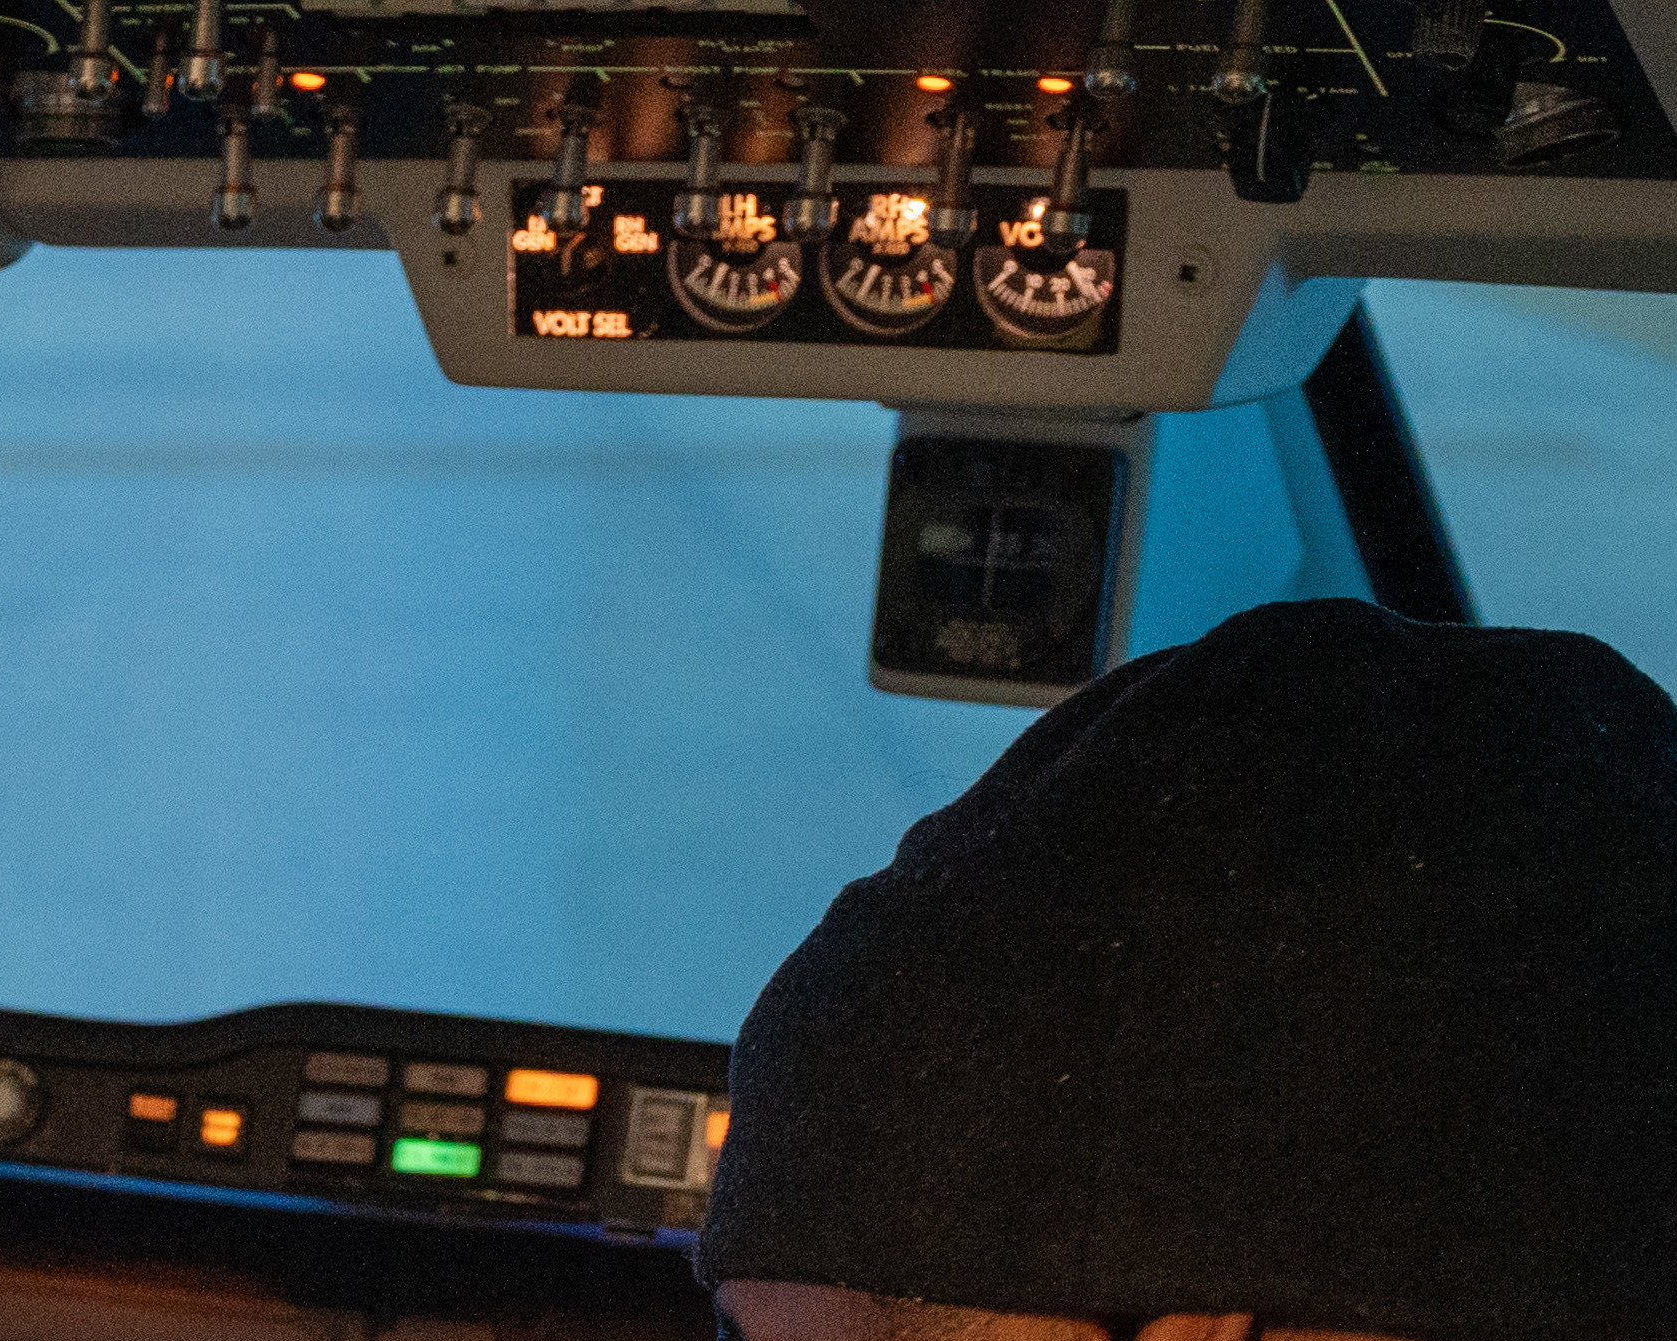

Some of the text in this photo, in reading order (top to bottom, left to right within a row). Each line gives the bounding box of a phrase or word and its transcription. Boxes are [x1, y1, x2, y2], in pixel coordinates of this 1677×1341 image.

[711, 215, 777, 242] MPS
[533, 310, 632, 338] VOLT SEL
